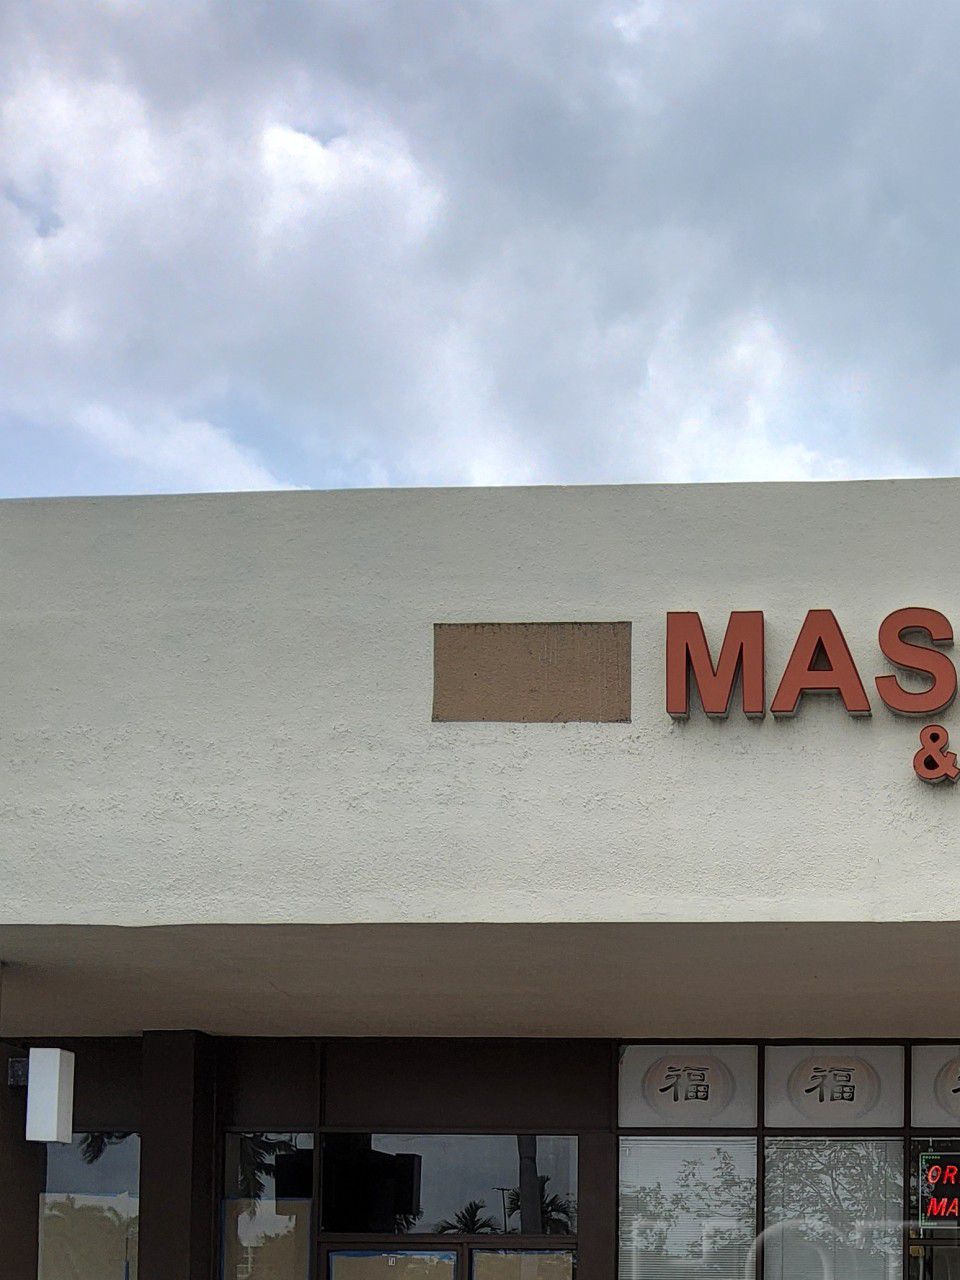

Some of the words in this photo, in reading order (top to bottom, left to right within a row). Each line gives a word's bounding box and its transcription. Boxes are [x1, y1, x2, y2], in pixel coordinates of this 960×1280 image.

[913, 724, 960, 783] &
[658, 1065, 711, 1103] 福
[803, 1065, 856, 1103] 福
